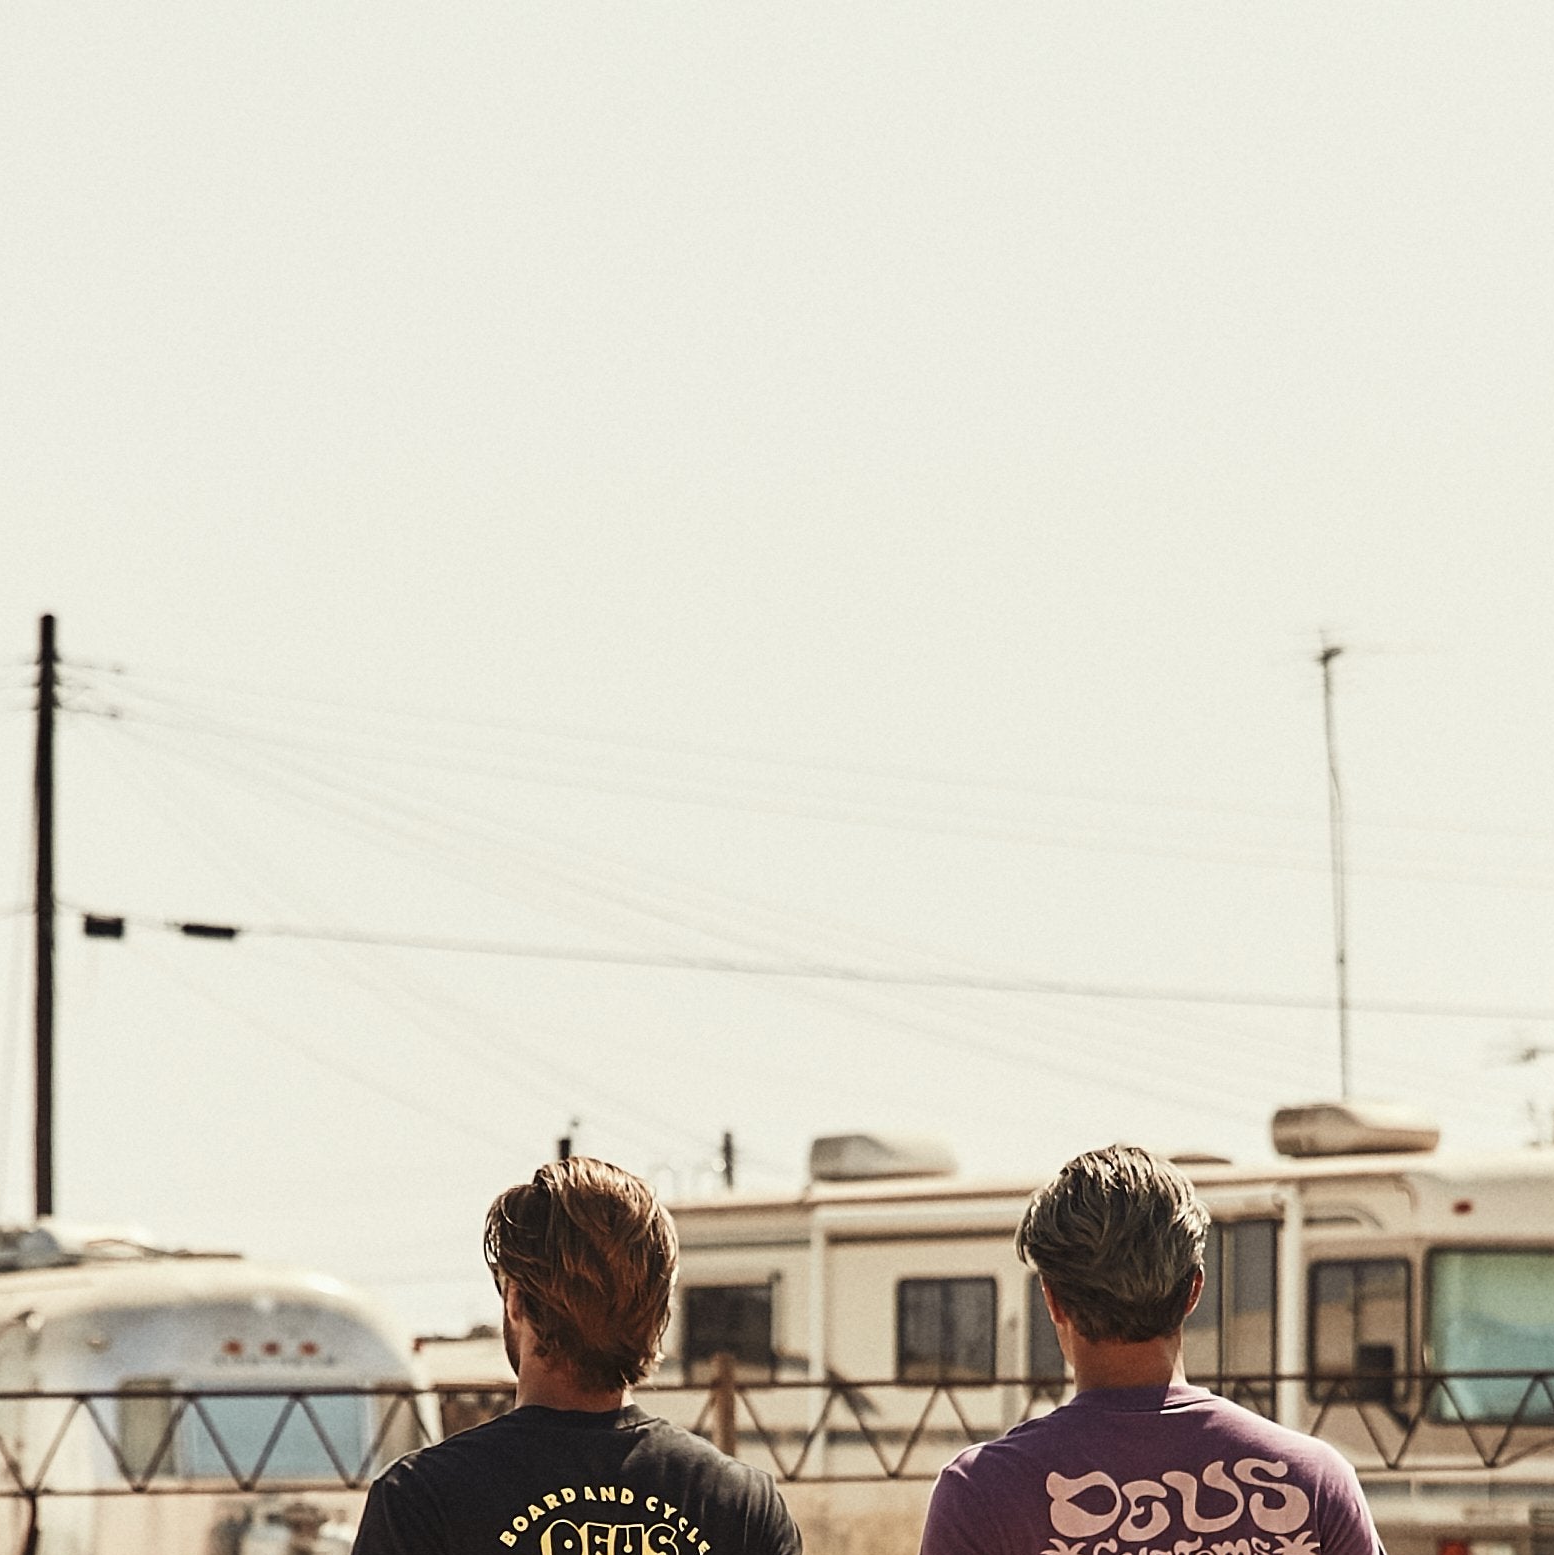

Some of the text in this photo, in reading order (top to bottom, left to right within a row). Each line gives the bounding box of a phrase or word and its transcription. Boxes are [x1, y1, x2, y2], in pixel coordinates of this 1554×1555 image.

[499, 1486, 577, 1548] BOARD
[583, 1486, 635, 1506] AND
[1046, 1458, 1310, 1542] DEUS
